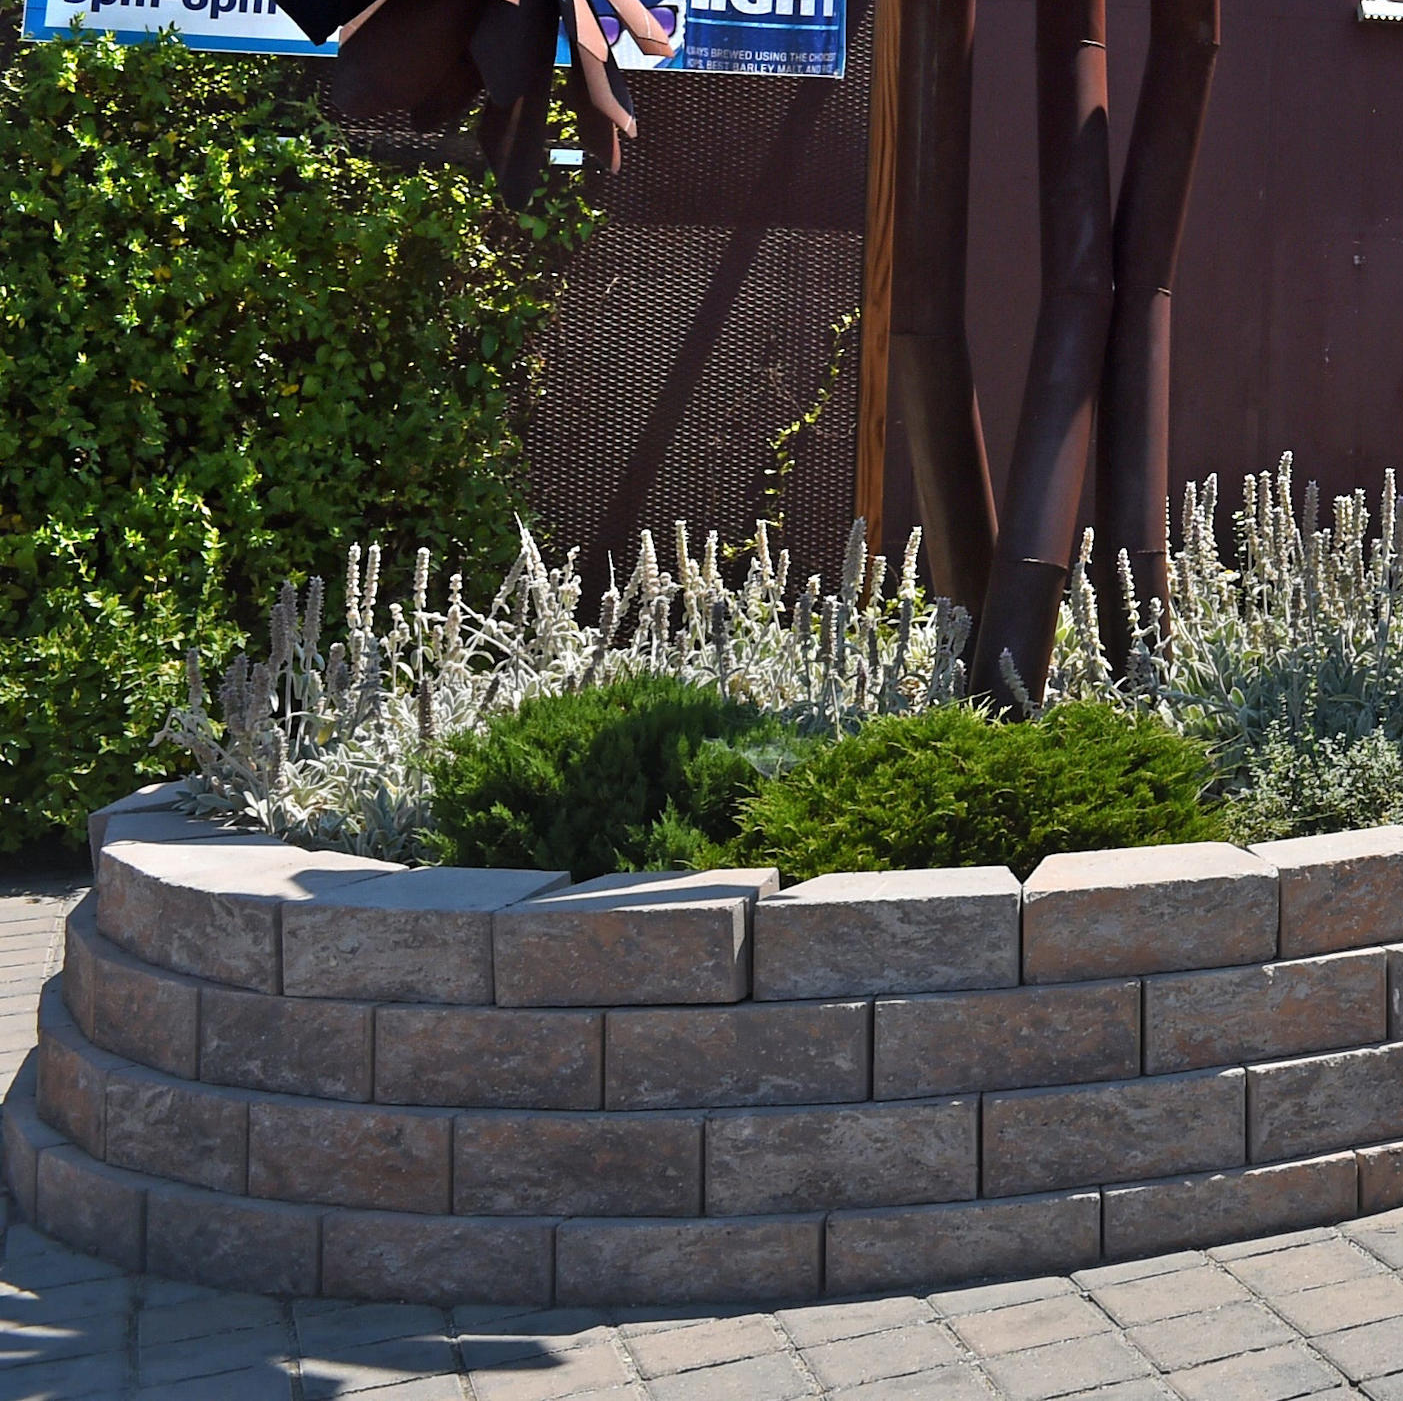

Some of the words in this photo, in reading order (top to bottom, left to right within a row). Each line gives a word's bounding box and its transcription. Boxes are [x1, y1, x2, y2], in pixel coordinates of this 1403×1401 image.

[711, 48, 752, 60] BREWED
[755, 51, 787, 63] USING
[790, 52, 807, 63] THE
[706, 60, 729, 70] BEST
[733, 62, 775, 74] BARLEY
[805, 64, 821, 74] AND
